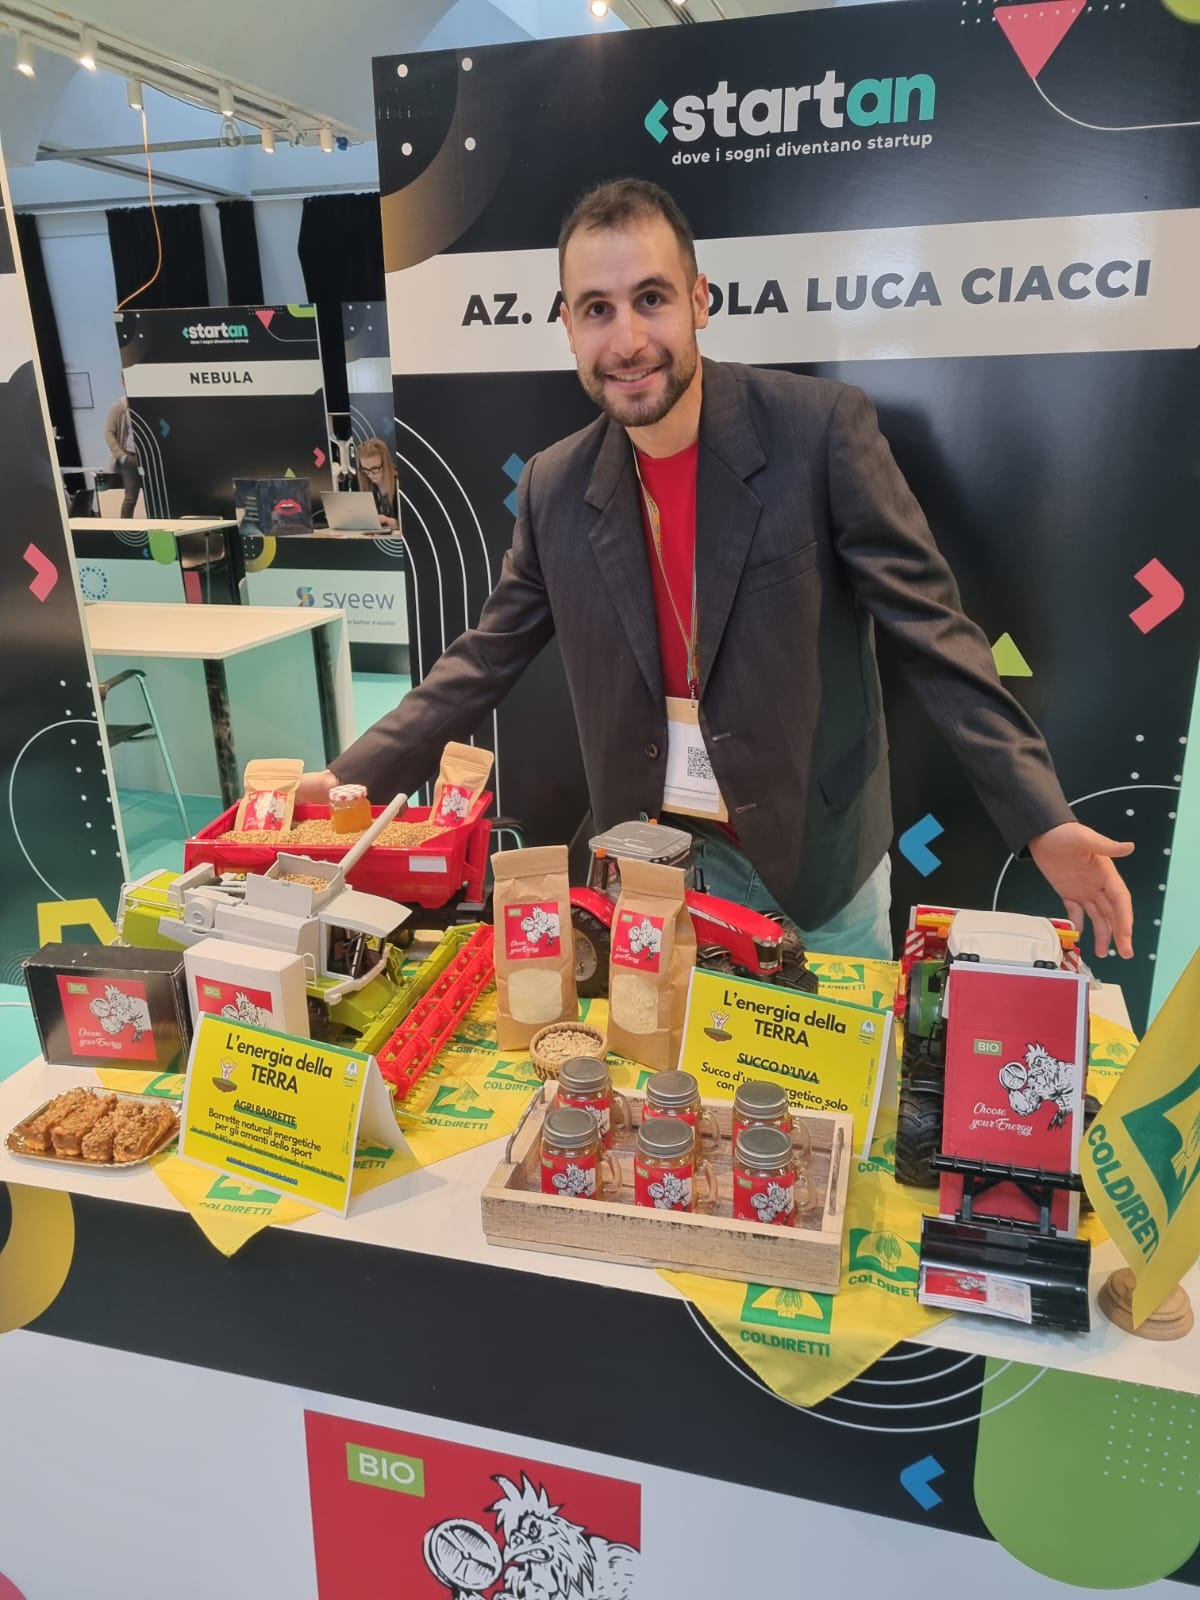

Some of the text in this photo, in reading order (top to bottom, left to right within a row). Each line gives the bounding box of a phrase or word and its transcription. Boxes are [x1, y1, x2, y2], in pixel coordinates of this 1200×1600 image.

[671, 70, 936, 142] startan
[672, 134, 933, 165] dove i sogni diventano startup
[461, 293, 533, 326] AZ.
[807, 271, 942, 312] LUCA
[961, 259, 1152, 305] CIACCI
[188, 322, 249, 339] startan
[190, 371, 253, 384] NEBULA
[723, 990, 847, 1034] L'energia della
[754, 1019, 810, 1047] TERRA
[977, 1041, 999, 1053] BIO
[226, 1032, 333, 1078] L'energia della
[737, 1052, 820, 1084] SUCCO D'UVA
[251, 1064, 298, 1094] TERRA
[701, 1061, 731, 1079] Succo
[784, 1087, 823, 1105] rgetico
[825, 1098, 849, 1112] solo
[716, 1080, 735, 1091] con
[973, 1101, 1006, 1116] Choose
[208, 1107, 322, 1152] Barrette naturali energetiche
[215, 1122, 313, 1160] per gli amanti dello sport
[969, 1117, 1033, 1137] your Energy
[740, 1329, 831, 1358] COLDIRETTI
[359, 1452, 416, 1485] BIO
